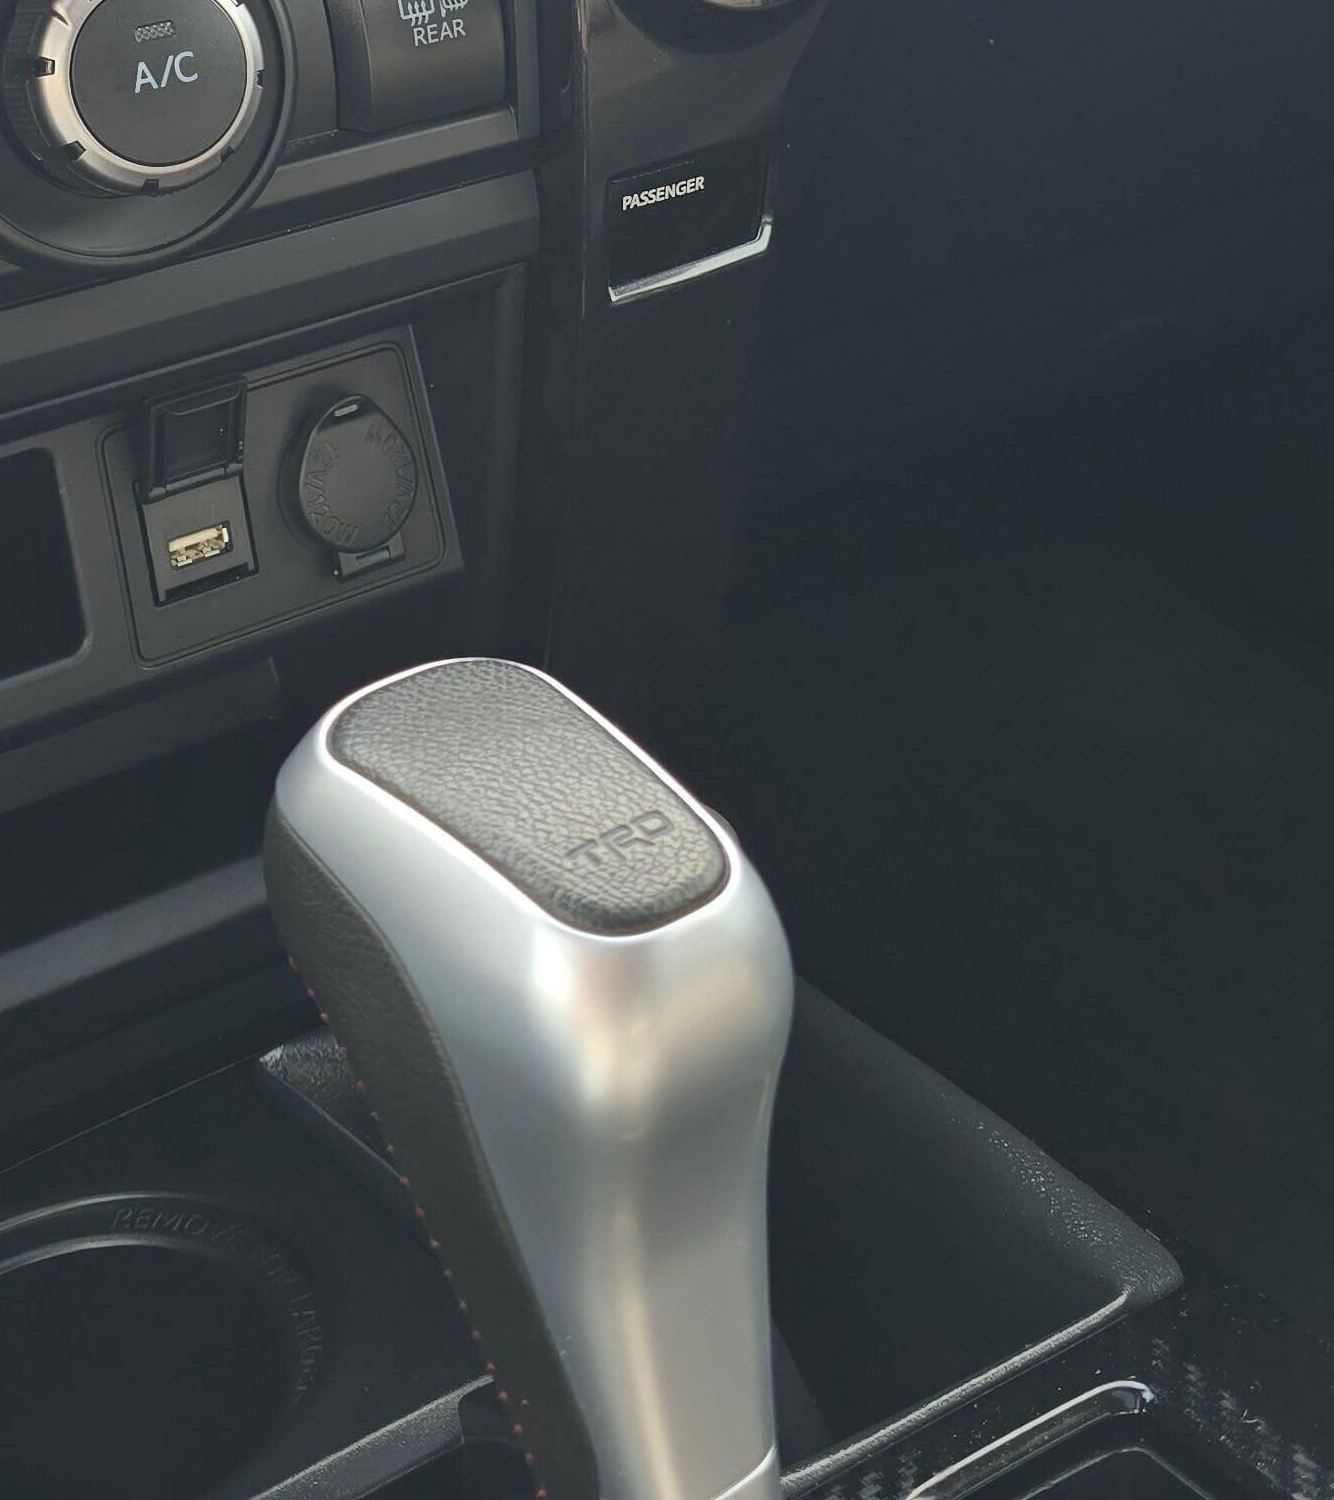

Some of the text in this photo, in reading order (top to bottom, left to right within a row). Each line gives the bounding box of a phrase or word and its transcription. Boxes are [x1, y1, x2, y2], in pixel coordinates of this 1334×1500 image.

[413, 17, 467, 47] REAR
[133, 50, 199, 94] A/C
[622, 175, 705, 211] PASSENGER
[567, 809, 674, 868] TRD
